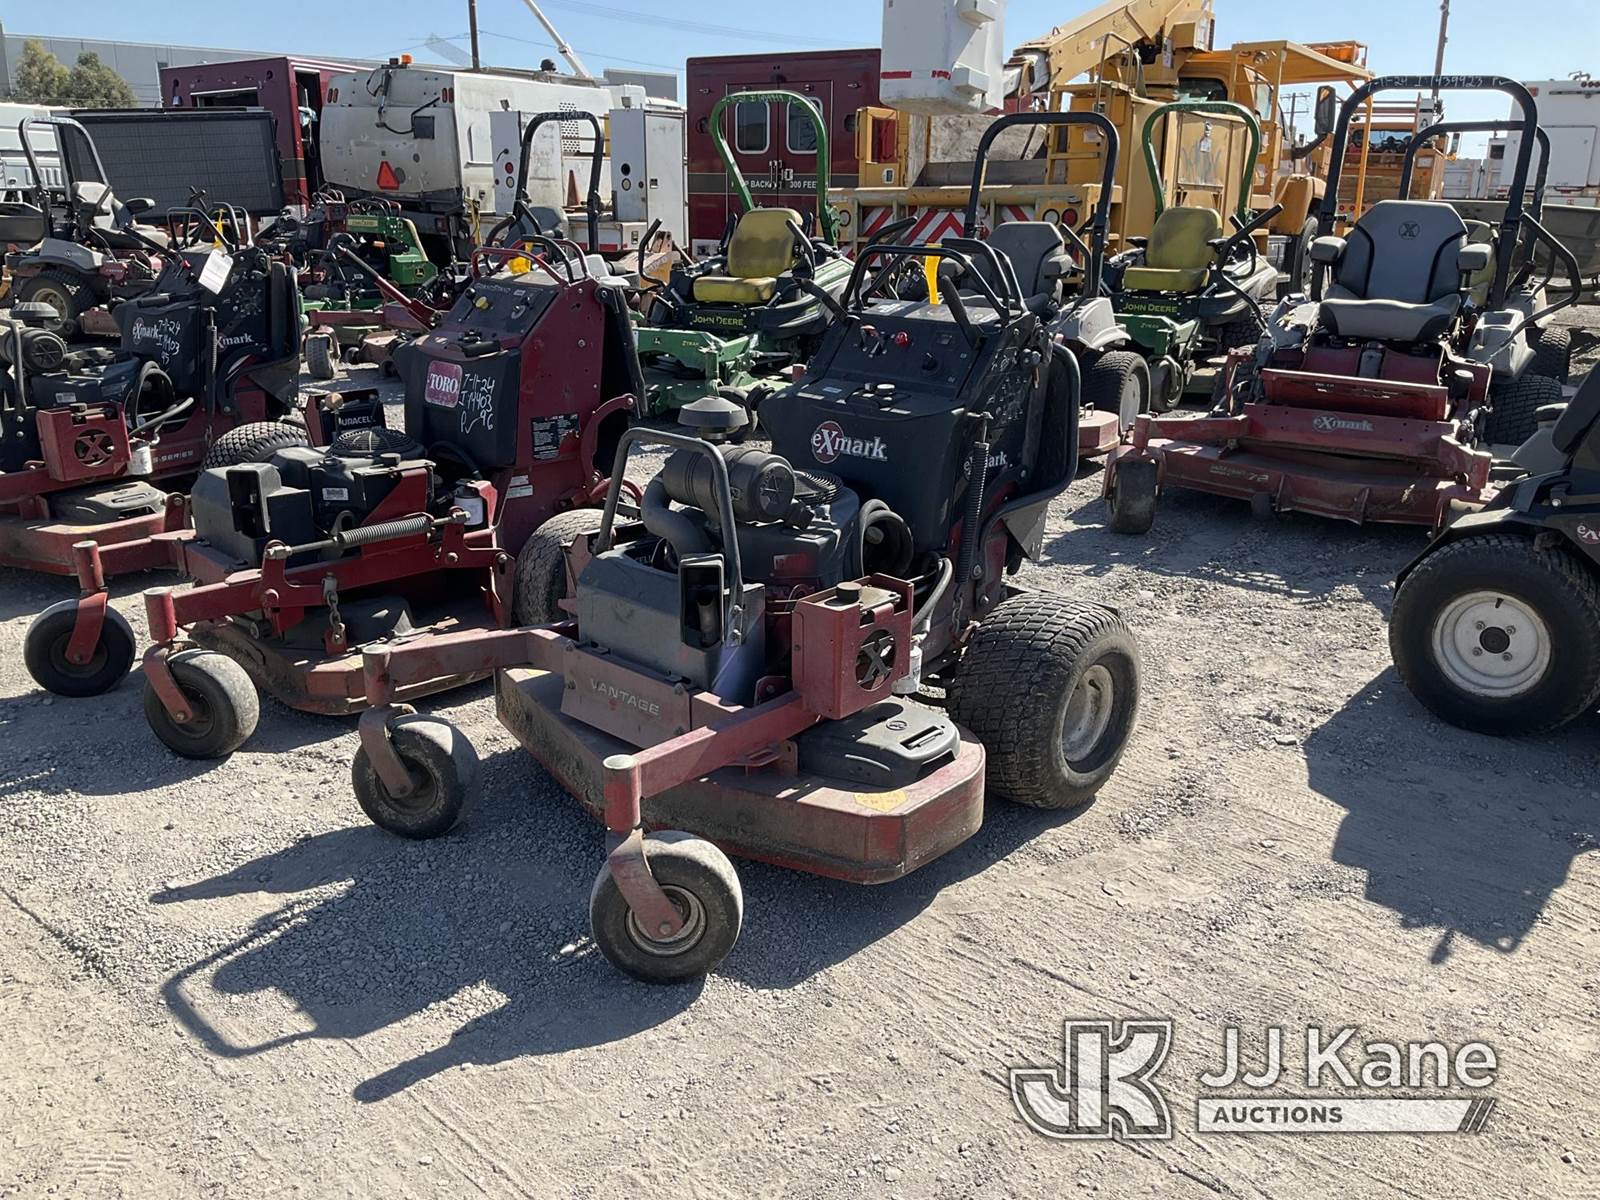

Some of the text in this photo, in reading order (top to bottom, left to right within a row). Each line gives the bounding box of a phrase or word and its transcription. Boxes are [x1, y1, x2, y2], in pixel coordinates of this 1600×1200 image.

[803, 181, 818, 189] FEE
[1123, 303, 1177, 313] JOHN DEERE
[693, 315, 744, 326] JOHN DEERE
[216, 332, 255, 349] Xmark
[430, 373, 459, 394] TORO
[462, 373, 496, 394] 7-11-24
[1313, 416, 1374, 432] eXmark
[812, 427, 888, 461] eXmark
[964, 450, 1007, 473] eark
[589, 678, 660, 716] VANTAGE
